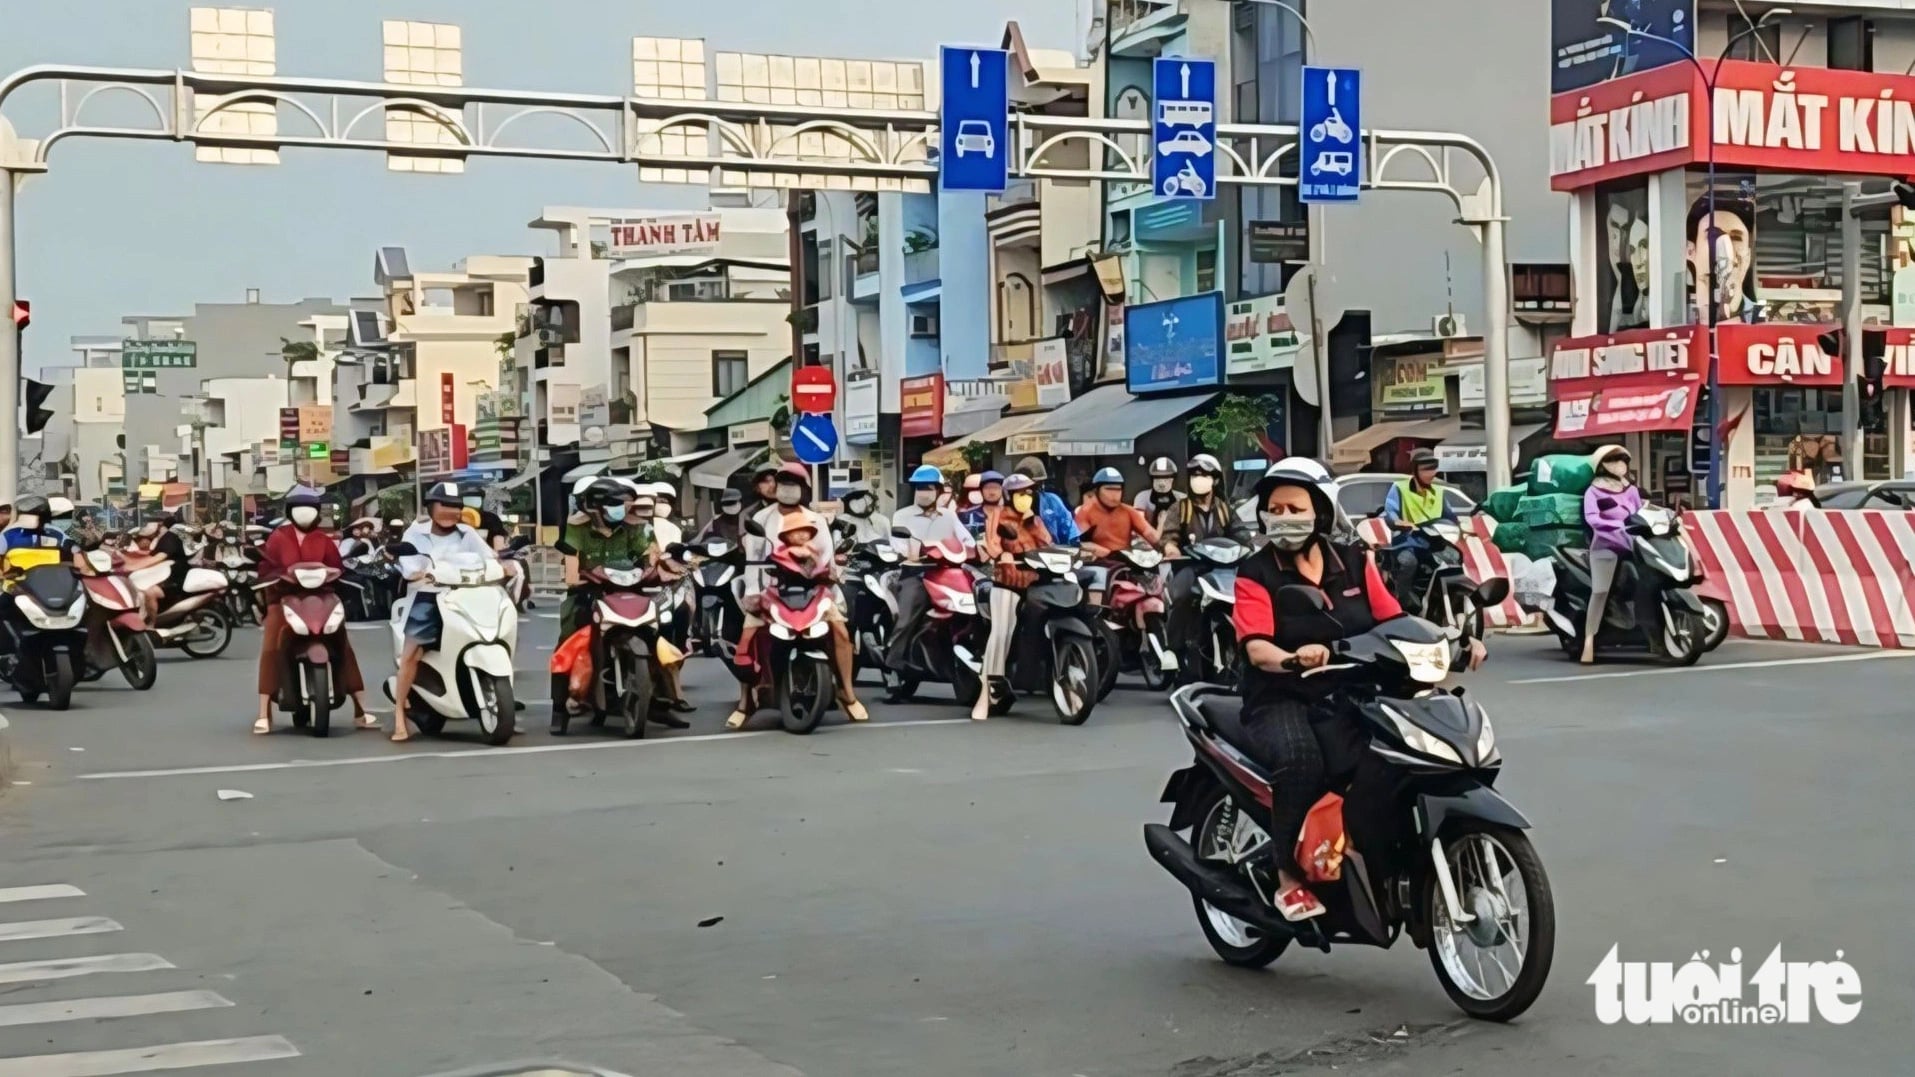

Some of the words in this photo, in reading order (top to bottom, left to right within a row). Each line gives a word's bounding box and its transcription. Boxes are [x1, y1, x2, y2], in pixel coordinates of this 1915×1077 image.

[1609, 91, 1689, 162] KÍNH
[1713, 71, 1828, 150] MẮT
[611, 225, 676, 246] THANH
[1747, 337, 1831, 381] CẬN
